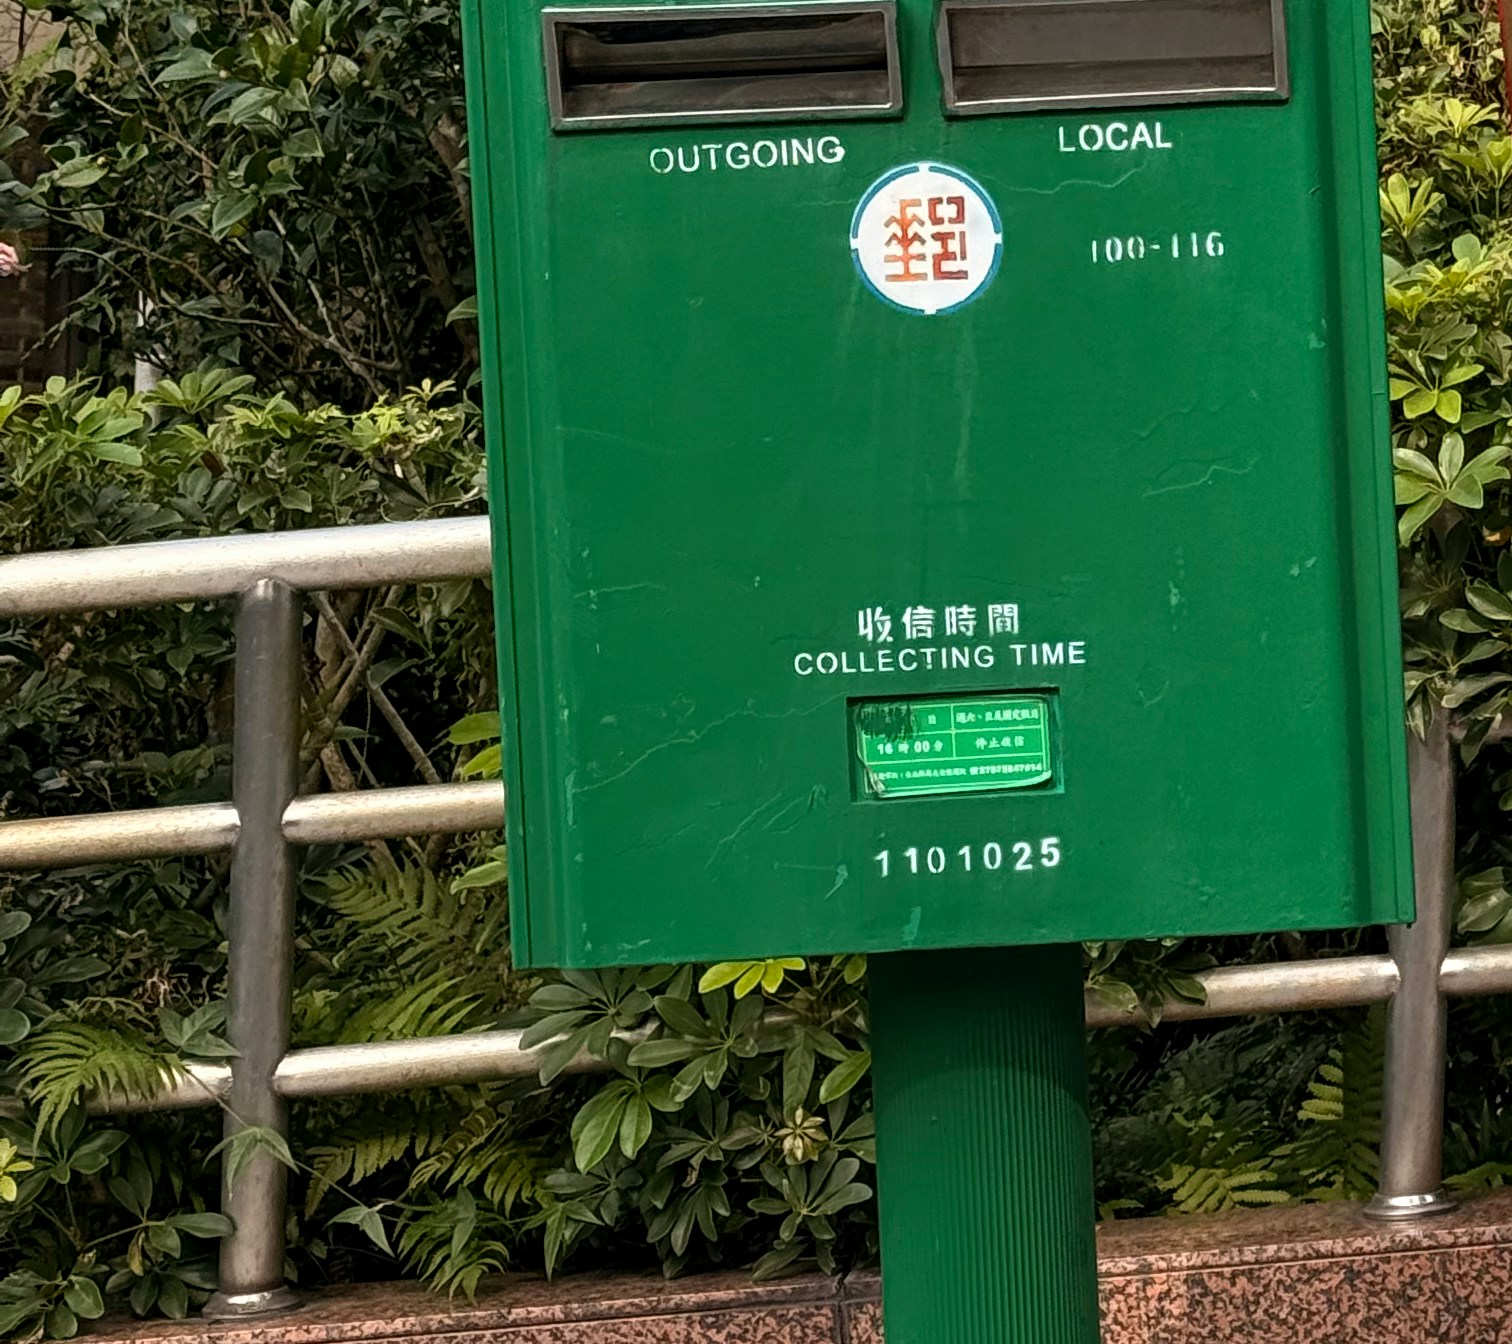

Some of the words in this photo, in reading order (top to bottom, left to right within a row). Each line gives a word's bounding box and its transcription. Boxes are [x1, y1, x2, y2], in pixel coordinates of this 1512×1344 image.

[649, 135, 846, 174] OUTGOING
[1058, 121, 1173, 152] LOCAL
[1091, 231, 1224, 263] 100-116
[858, 603, 1019, 643] 收信時間
[794, 645, 995, 676] COLLECTING
[1009, 641, 1086, 666] TIME
[875, 836, 1061, 877] 1101025
